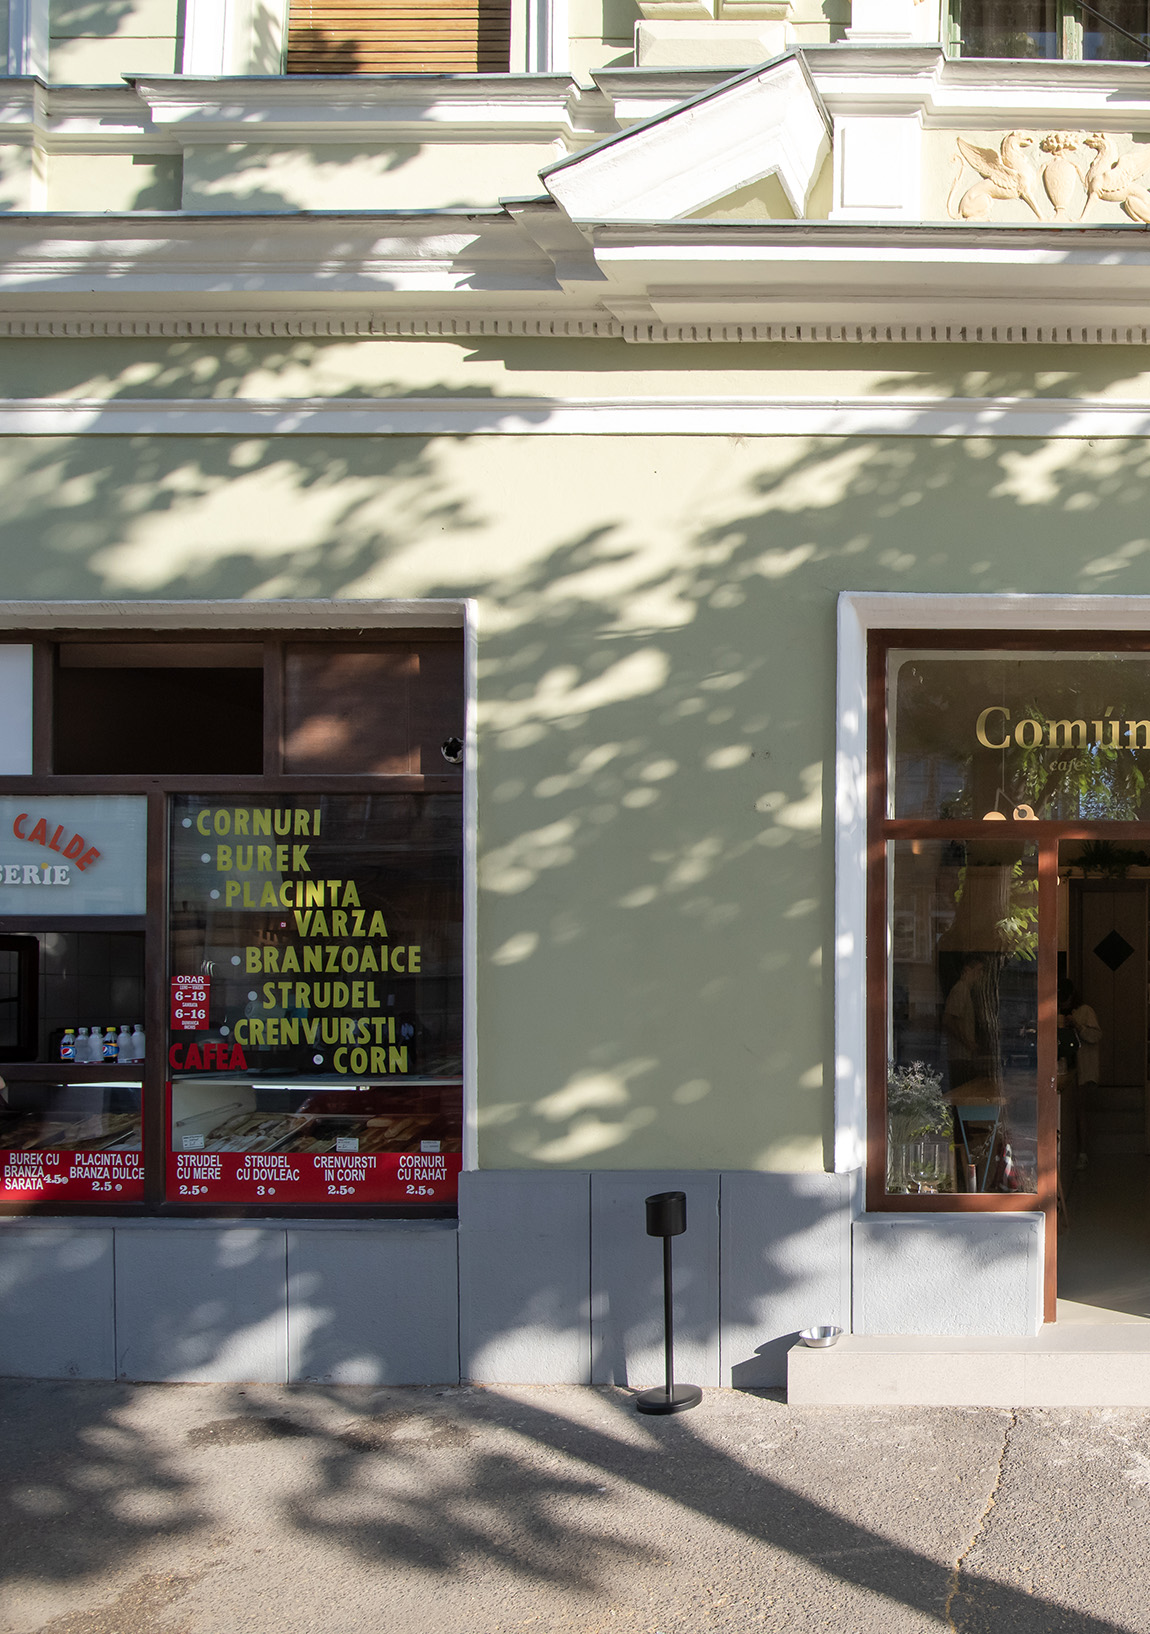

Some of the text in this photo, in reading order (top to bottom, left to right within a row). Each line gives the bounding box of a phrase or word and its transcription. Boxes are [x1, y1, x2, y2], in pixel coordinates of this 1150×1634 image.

[197, 809, 321, 836] CORNURI
[13, 813, 100, 872] CALDE
[217, 845, 311, 872] BUREK
[0, 862, 70, 885] ERIE
[226, 880, 360, 907] PLACINTA
[294, 910, 388, 937] VARZA
[246, 946, 421, 973] BRANZOAICE
[177, 975, 205, 984] ORAR
[262, 981, 380, 1009] STRUDEL
[234, 1017, 396, 1045] CRENVURSTI
[169, 1043, 248, 1070] CAFEA
[333, 1046, 408, 1074] CORN
[9, 1153, 60, 1166] BUREK CU
[75, 1153, 139, 1166] PLACINTA CU
[177, 1154, 223, 1167] STRUDEL
[244, 1155, 290, 1168] STRUDEL
[313, 1156, 377, 1168] CRENVURSTI
[399, 1155, 445, 1168] CORNURI
[4, 1165, 44, 1178] BRANZA
[70, 1166, 145, 1180] BRANZA DULCE
[176, 1167, 221, 1180] CU MERE
[236, 1168, 300, 1181] CU DOVLEAC
[324, 1169, 366, 1181] IN CORN
[397, 1168, 447, 1180] CU RAHAT
[5, 1178, 44, 1190] SARATA
[43, 1174, 62, 1184] 4.5
[92, 1181, 112, 1191] 2.5
[179, 1184, 200, 1195] 2.5
[256, 1185, 265, 1195] 3
[327, 1184, 348, 1195] 2.5
[406, 1184, 427, 1195] 2.5
